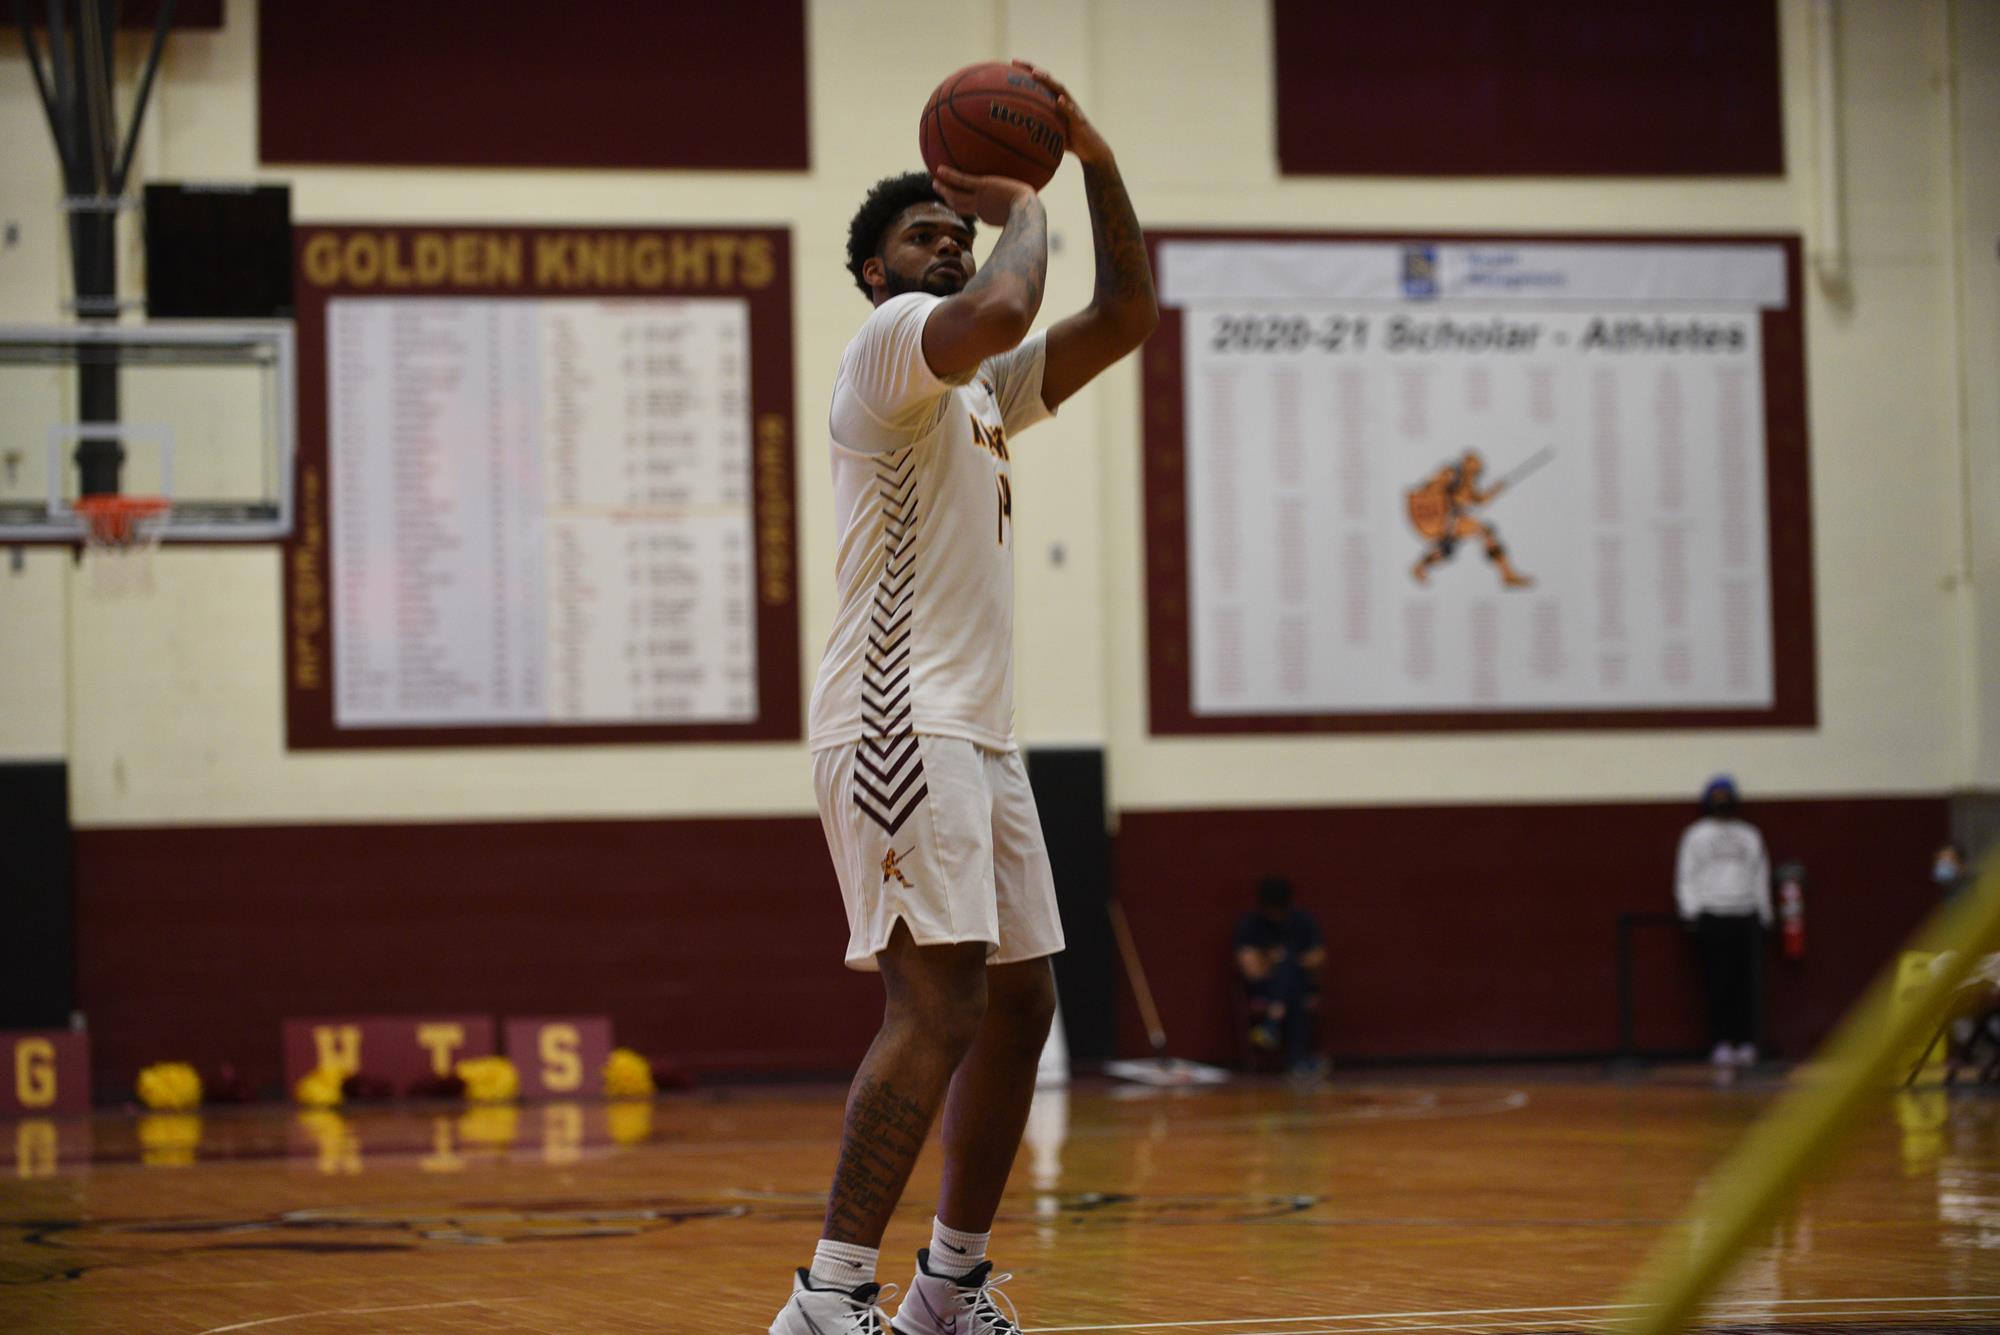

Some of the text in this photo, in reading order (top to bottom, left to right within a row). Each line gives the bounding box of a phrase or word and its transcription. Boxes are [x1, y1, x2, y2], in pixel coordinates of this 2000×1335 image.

[304, 233, 776, 287] GOLDEN KNIGHTS
[1213, 314, 1369, 353] 2020-21
[1384, 314, 1541, 353] Scholar
[1582, 316, 1746, 352] Athletes
[15, 1037, 57, 1107] G
[417, 1022, 464, 1076] T
[539, 1023, 583, 1092] S
